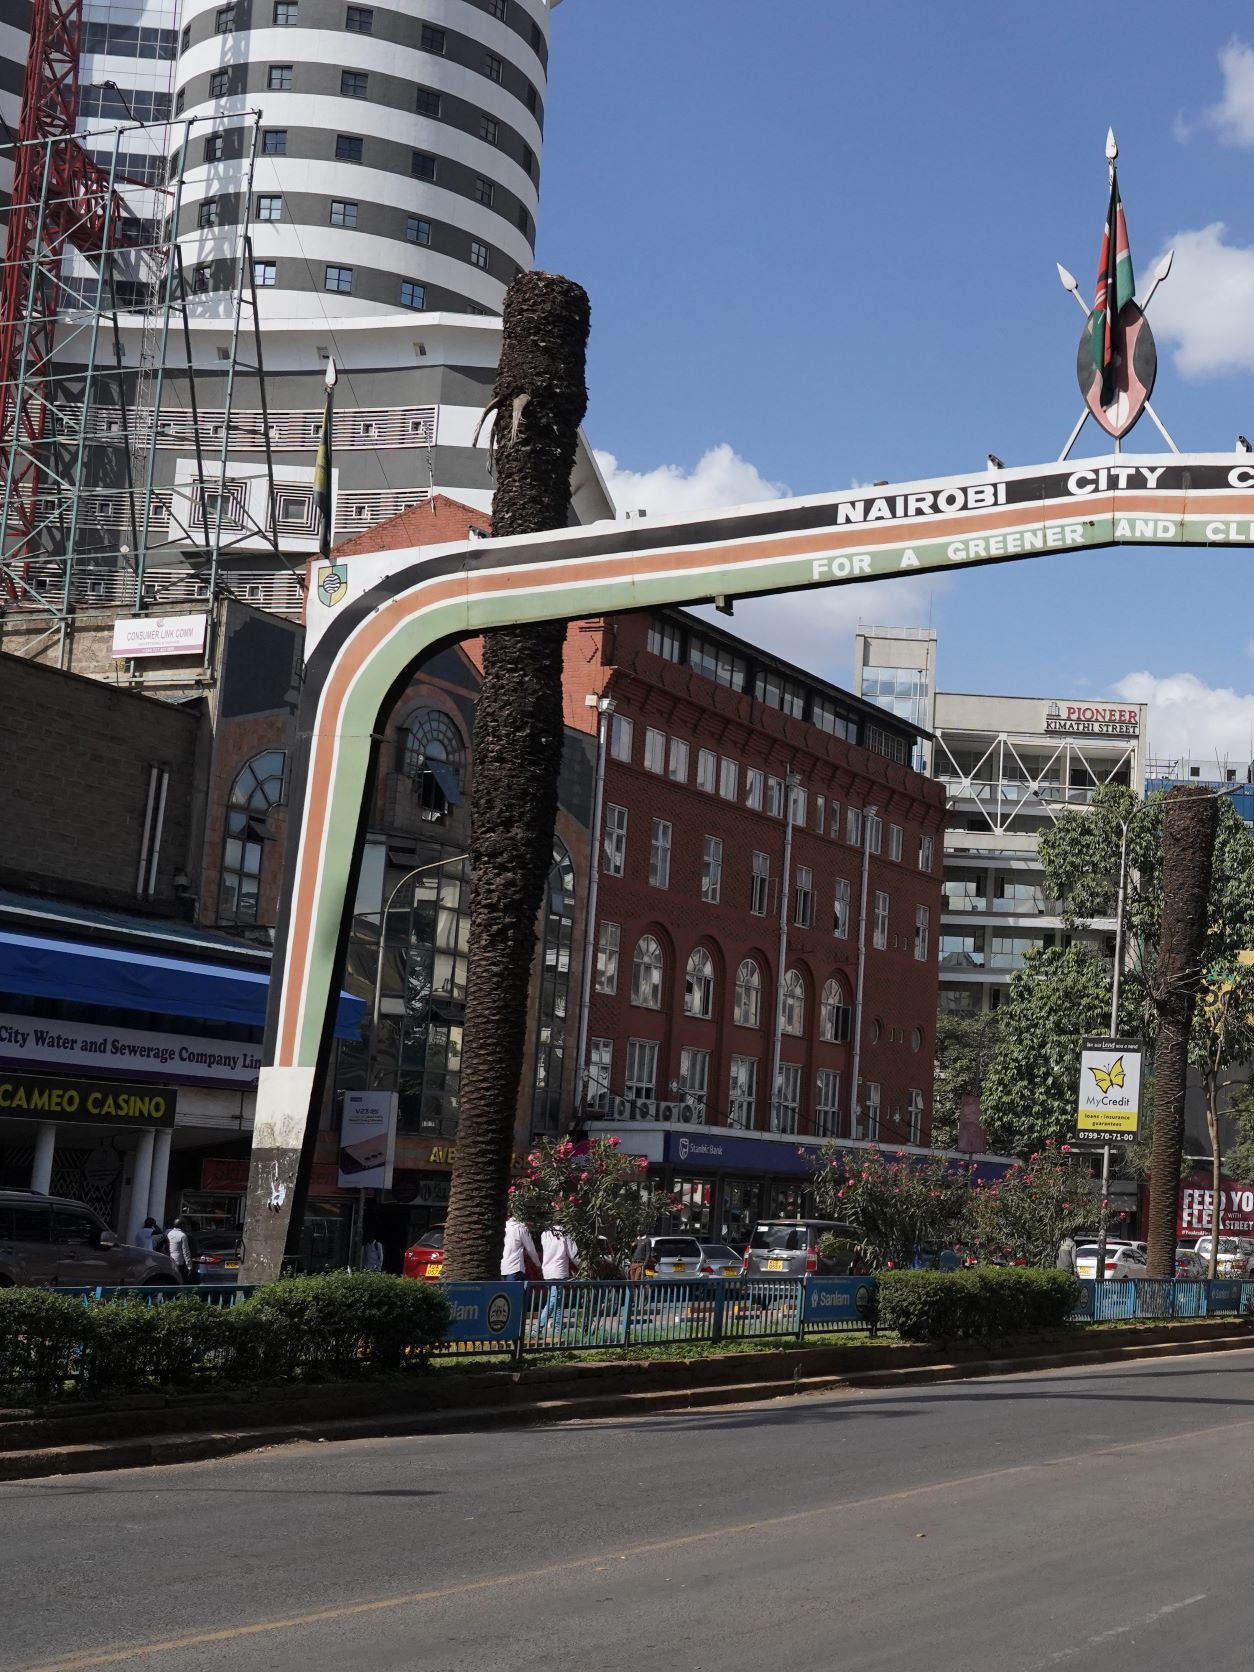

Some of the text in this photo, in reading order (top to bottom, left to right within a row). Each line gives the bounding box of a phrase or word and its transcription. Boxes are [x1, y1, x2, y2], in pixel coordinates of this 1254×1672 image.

[837, 482, 1007, 525] NAIROBI
[1067, 465, 1167, 498] CITY
[811, 555, 872, 581] FOR
[899, 547, 920, 569] A
[946, 523, 1085, 560] GREENER
[1115, 518, 1176, 538] AND
[160, 629, 174, 639] LINK
[1066, 706, 1138, 723] PIONEER
[1046, 721, 1138, 734] KIMATHI STREET
[0, 1025, 29, 1048] City
[33, 1029, 78, 1051] Water
[80, 1038, 108, 1054] and
[110, 1039, 176, 1064] Sewerage
[178, 1046, 240, 1070] Company
[0, 1083, 166, 1118] CAMEO CASINO
[1086, 1096, 1130, 1107] MyCredit
[1079, 1132, 1133, 1141] 0799-70-71-00
[819, 1290, 850, 1306] Sanlam
